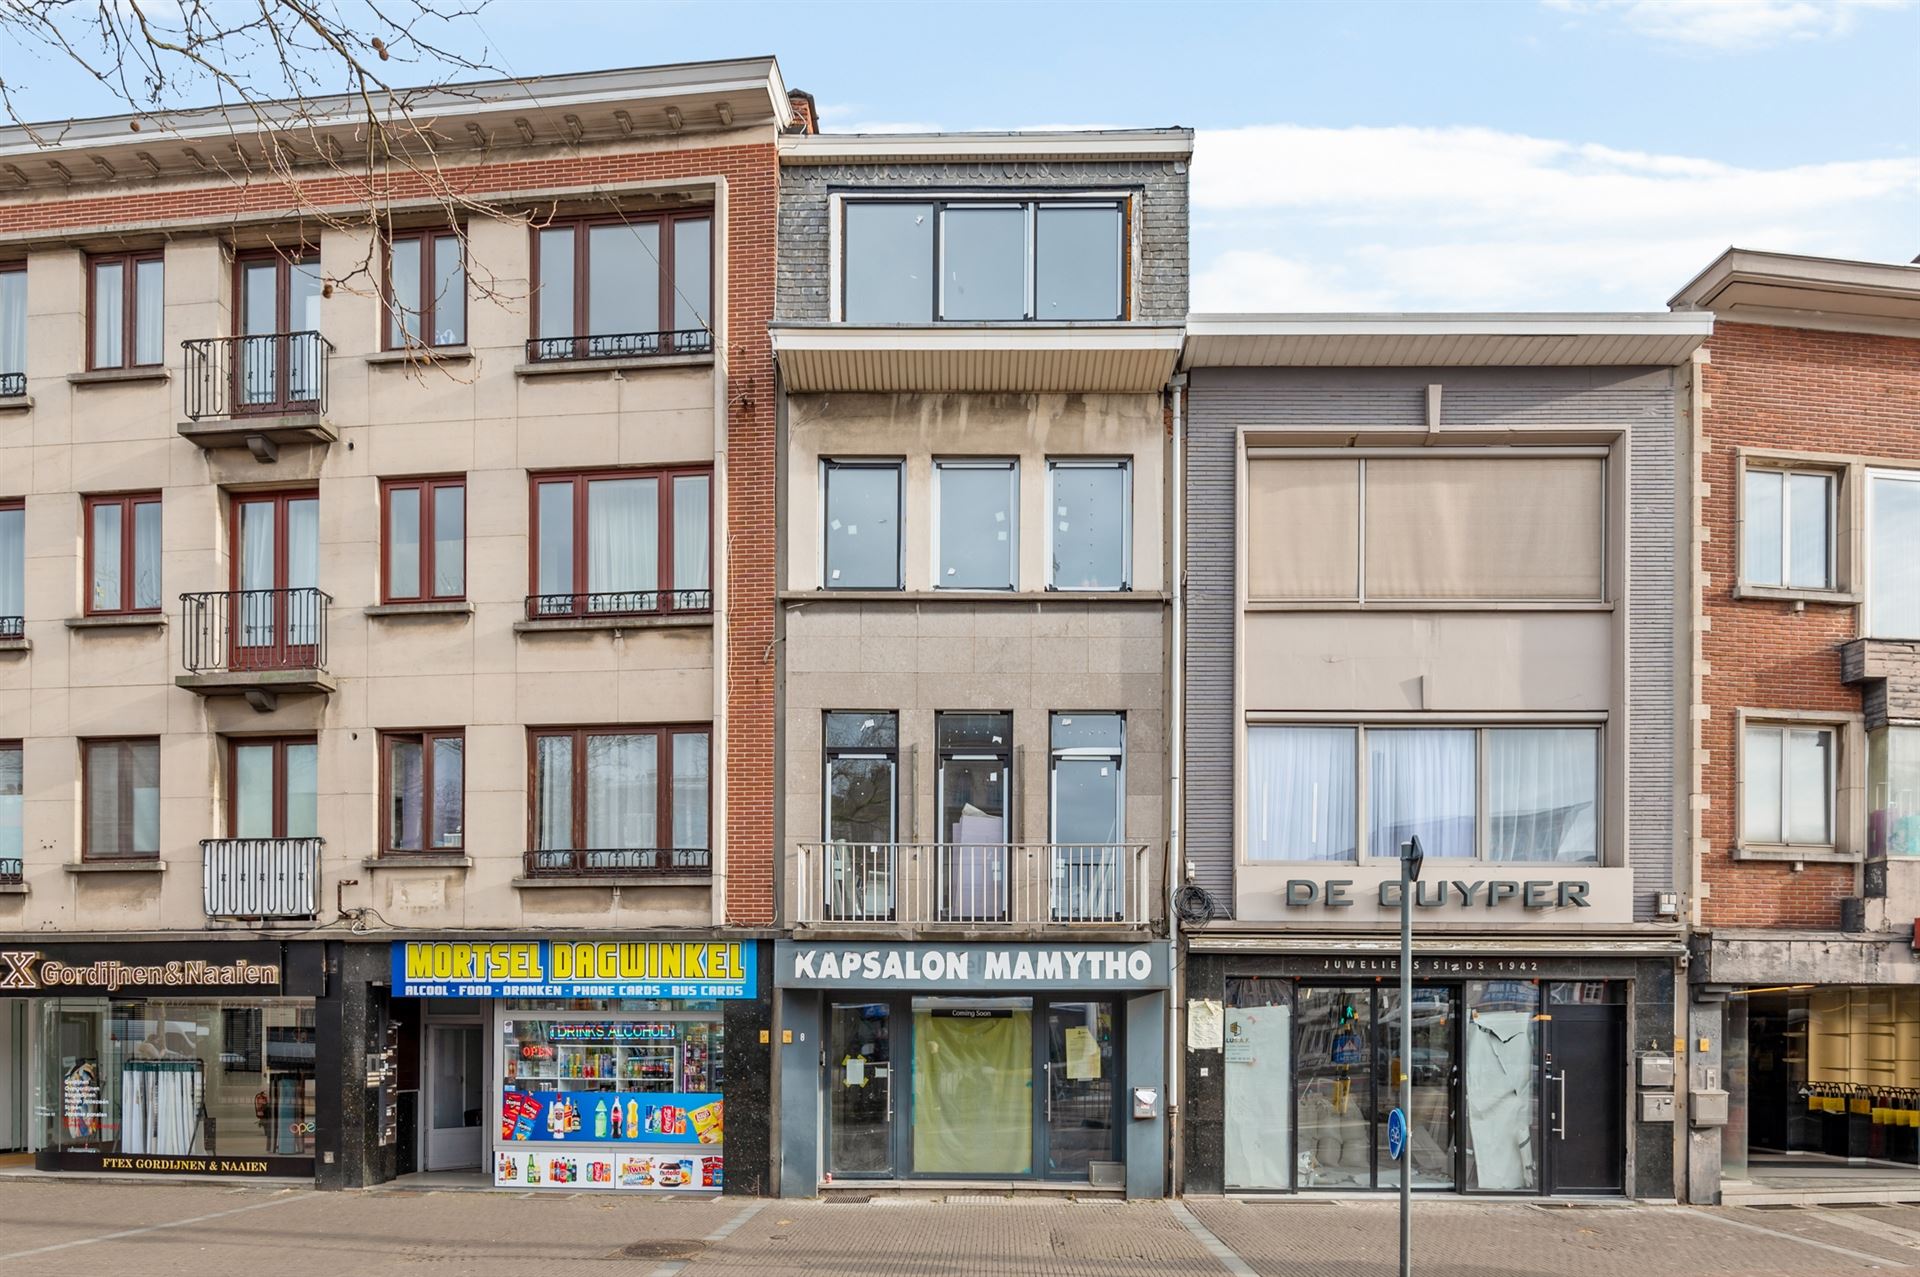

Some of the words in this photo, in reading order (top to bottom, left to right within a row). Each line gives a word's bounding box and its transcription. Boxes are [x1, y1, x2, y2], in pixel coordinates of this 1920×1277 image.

[1287, 880, 1353, 906] DE
[1379, 880, 1591, 907] CUYPER
[406, 942, 543, 981] MORTSEL
[552, 942, 745, 980] DAGWINKEL
[795, 950, 968, 980] KAPSALON
[984, 950, 1152, 980] MAMYTHO
[1324, 961, 1419, 969] JUWELIES
[1498, 962, 1537, 970] 1942
[405, 985, 448, 996] ALCOOL
[459, 985, 492, 996] FOOD
[503, 985, 562, 996] DRANKEN
[573, 985, 615, 996] PHONE
[619, 985, 660, 996] CARDS
[672, 985, 697, 996] BUS
[701, 985, 743, 996] CARDS
[557, 1025, 604, 1037] DRINKS
[800, 1033, 805, 1041] 8
[523, 1047, 553, 1057] OPEN
[103, 1158, 133, 1168] FTEX
[136, 1159, 206, 1171] GORDIJNEN
[209, 1161, 218, 1170] &
[221, 1161, 268, 1172] NAAIEN
